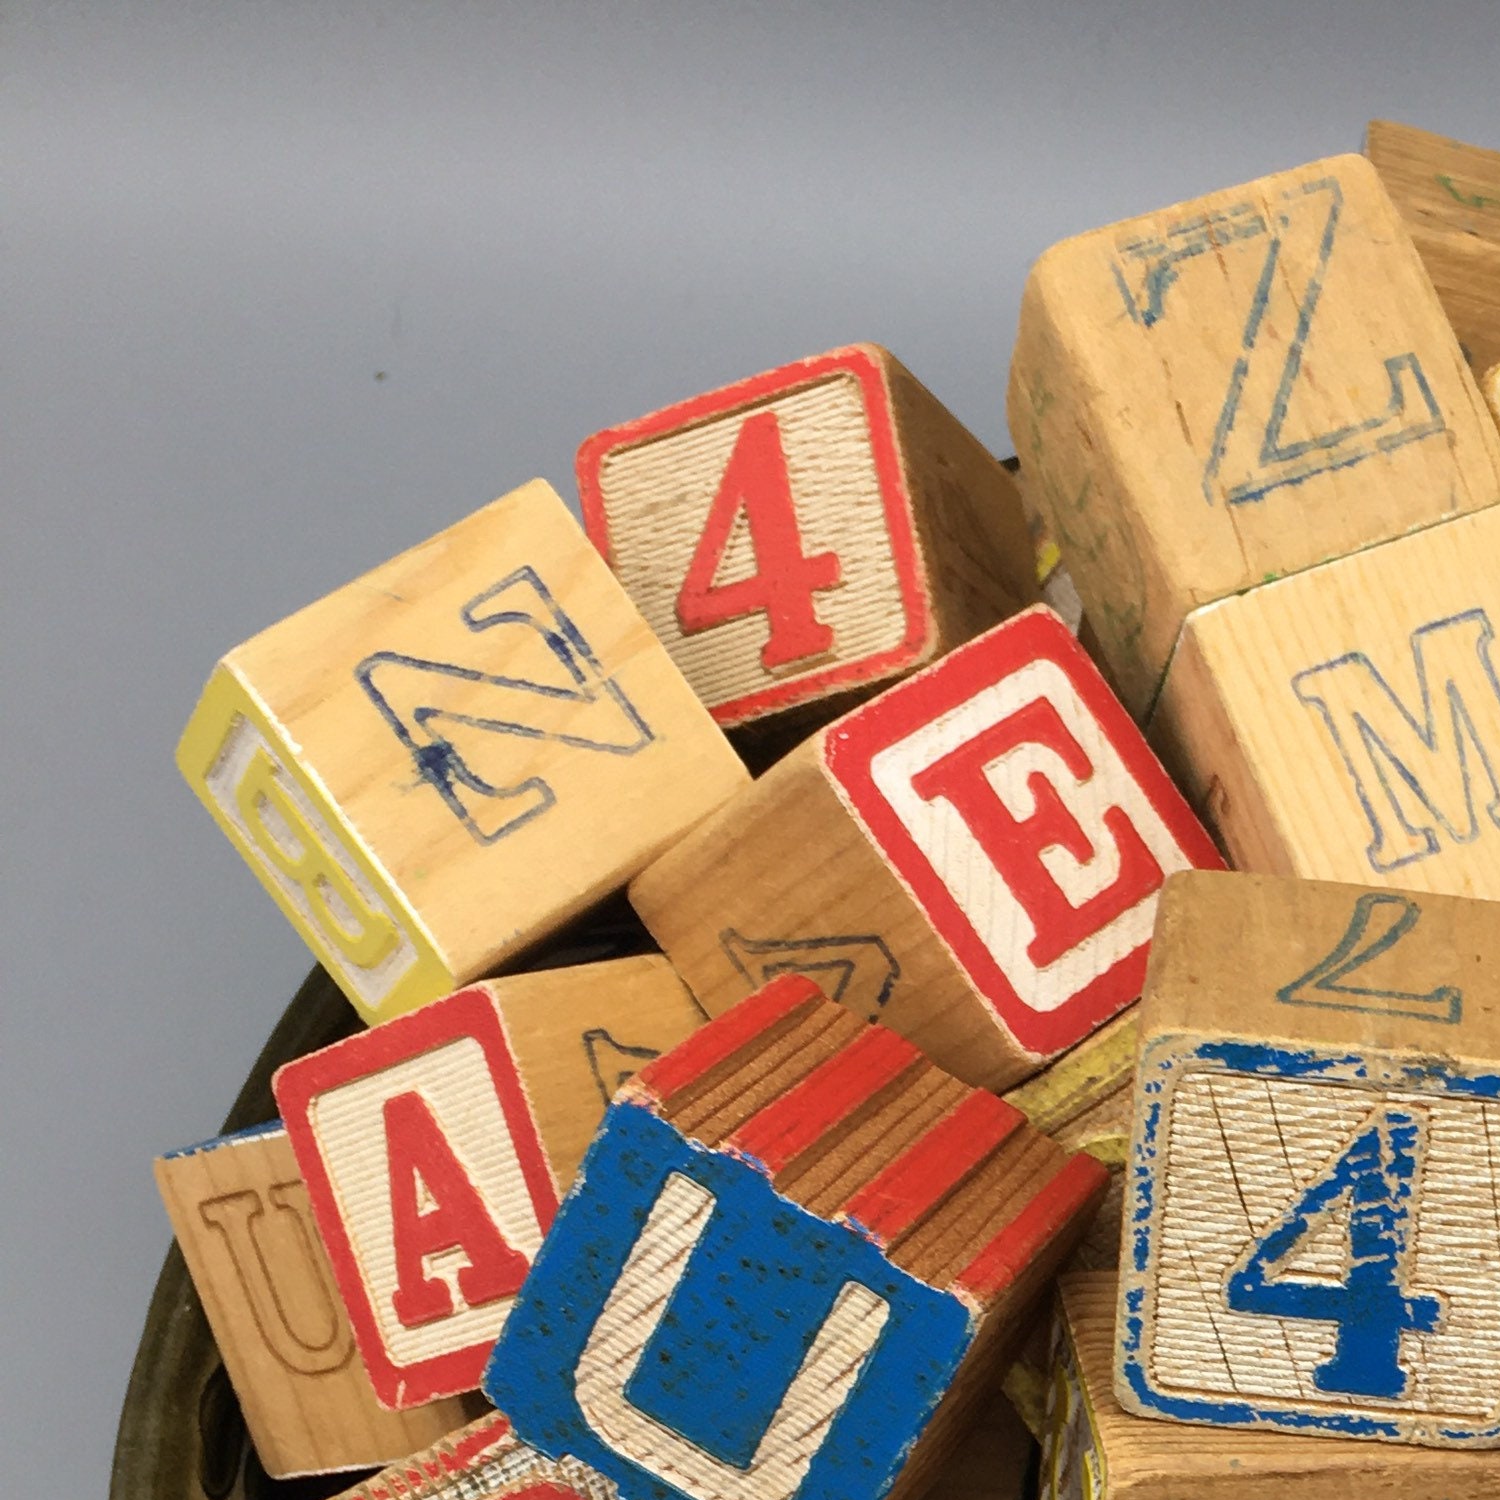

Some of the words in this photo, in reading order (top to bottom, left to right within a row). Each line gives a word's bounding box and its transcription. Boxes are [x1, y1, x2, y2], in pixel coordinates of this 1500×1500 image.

[1111, 176, 1447, 508] Z
[675, 411, 843, 674] 4
[910, 696, 1165, 971] E
[200, 1180, 355, 1377] U
[392, 1090, 533, 1328] A
[1226, 1108, 1442, 1399] 4
